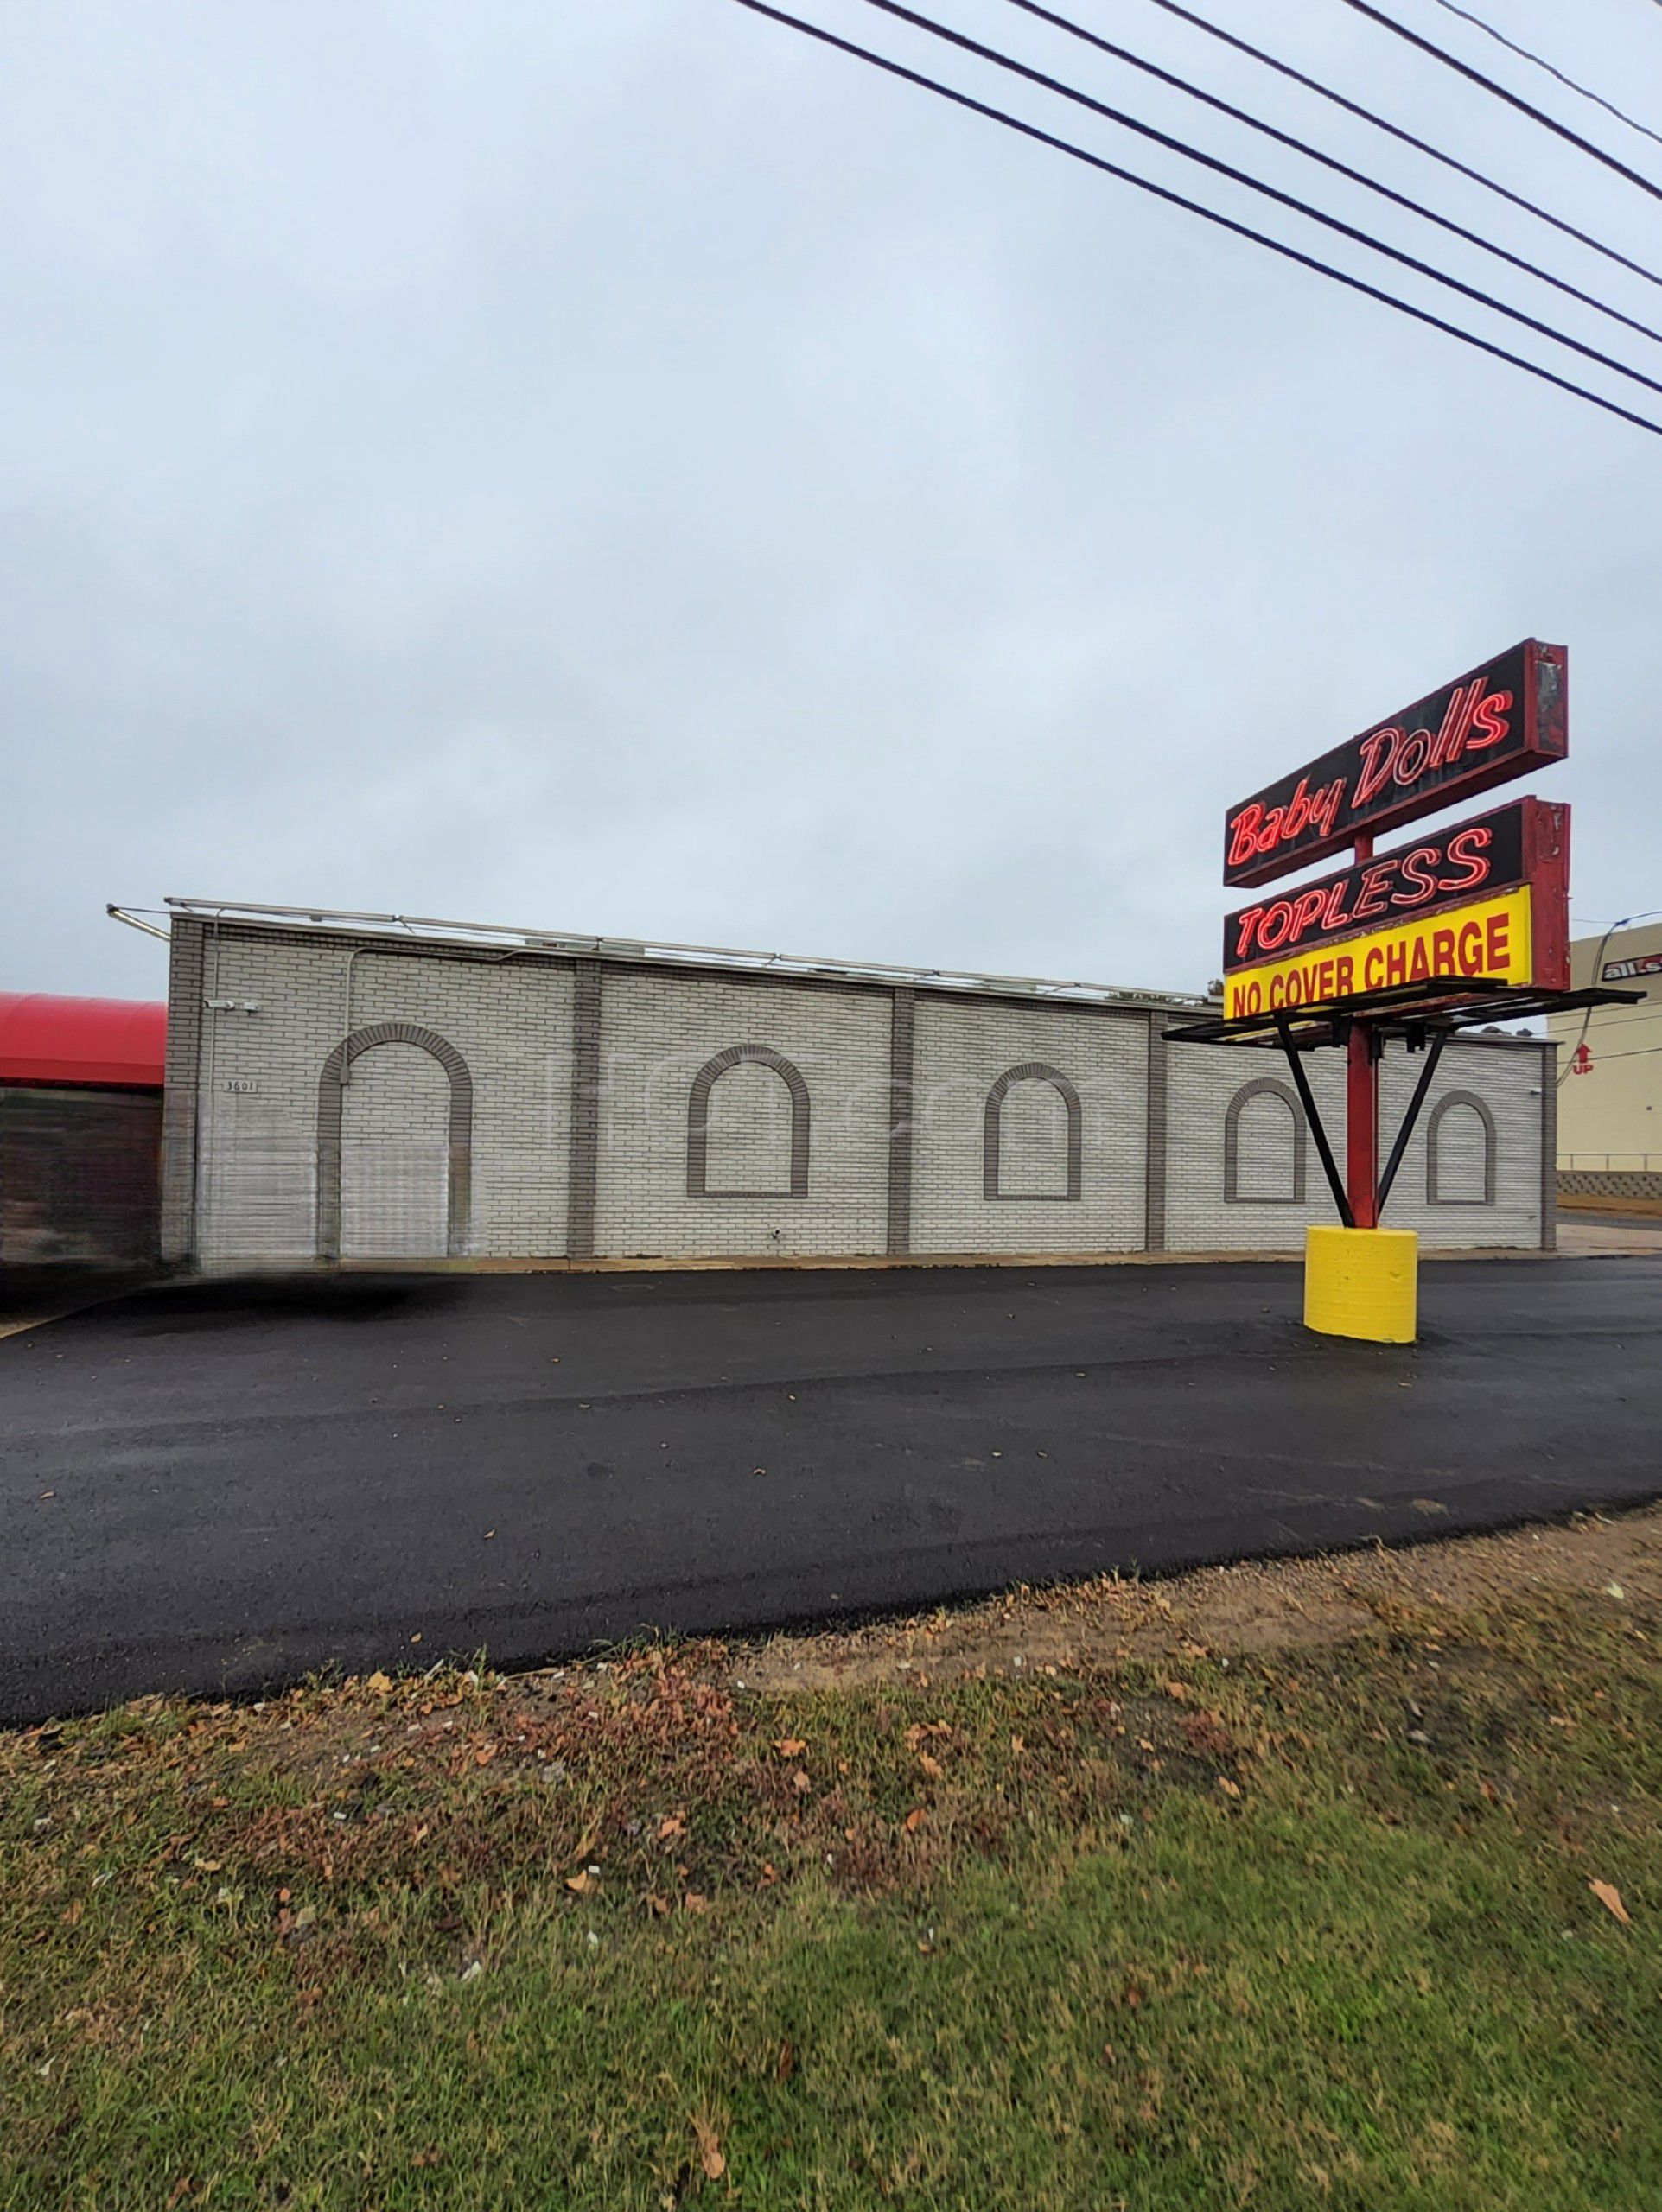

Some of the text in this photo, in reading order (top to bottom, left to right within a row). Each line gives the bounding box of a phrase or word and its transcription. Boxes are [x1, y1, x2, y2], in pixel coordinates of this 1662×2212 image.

[1228, 676, 1512, 866] Baby Dolls
[1237, 828, 1493, 957] TOPLESS
[1232, 912, 1511, 1018] NO COVER CHARGE
[227, 1081, 254, 1091] 3601
[1572, 1064, 1594, 1076] UP
